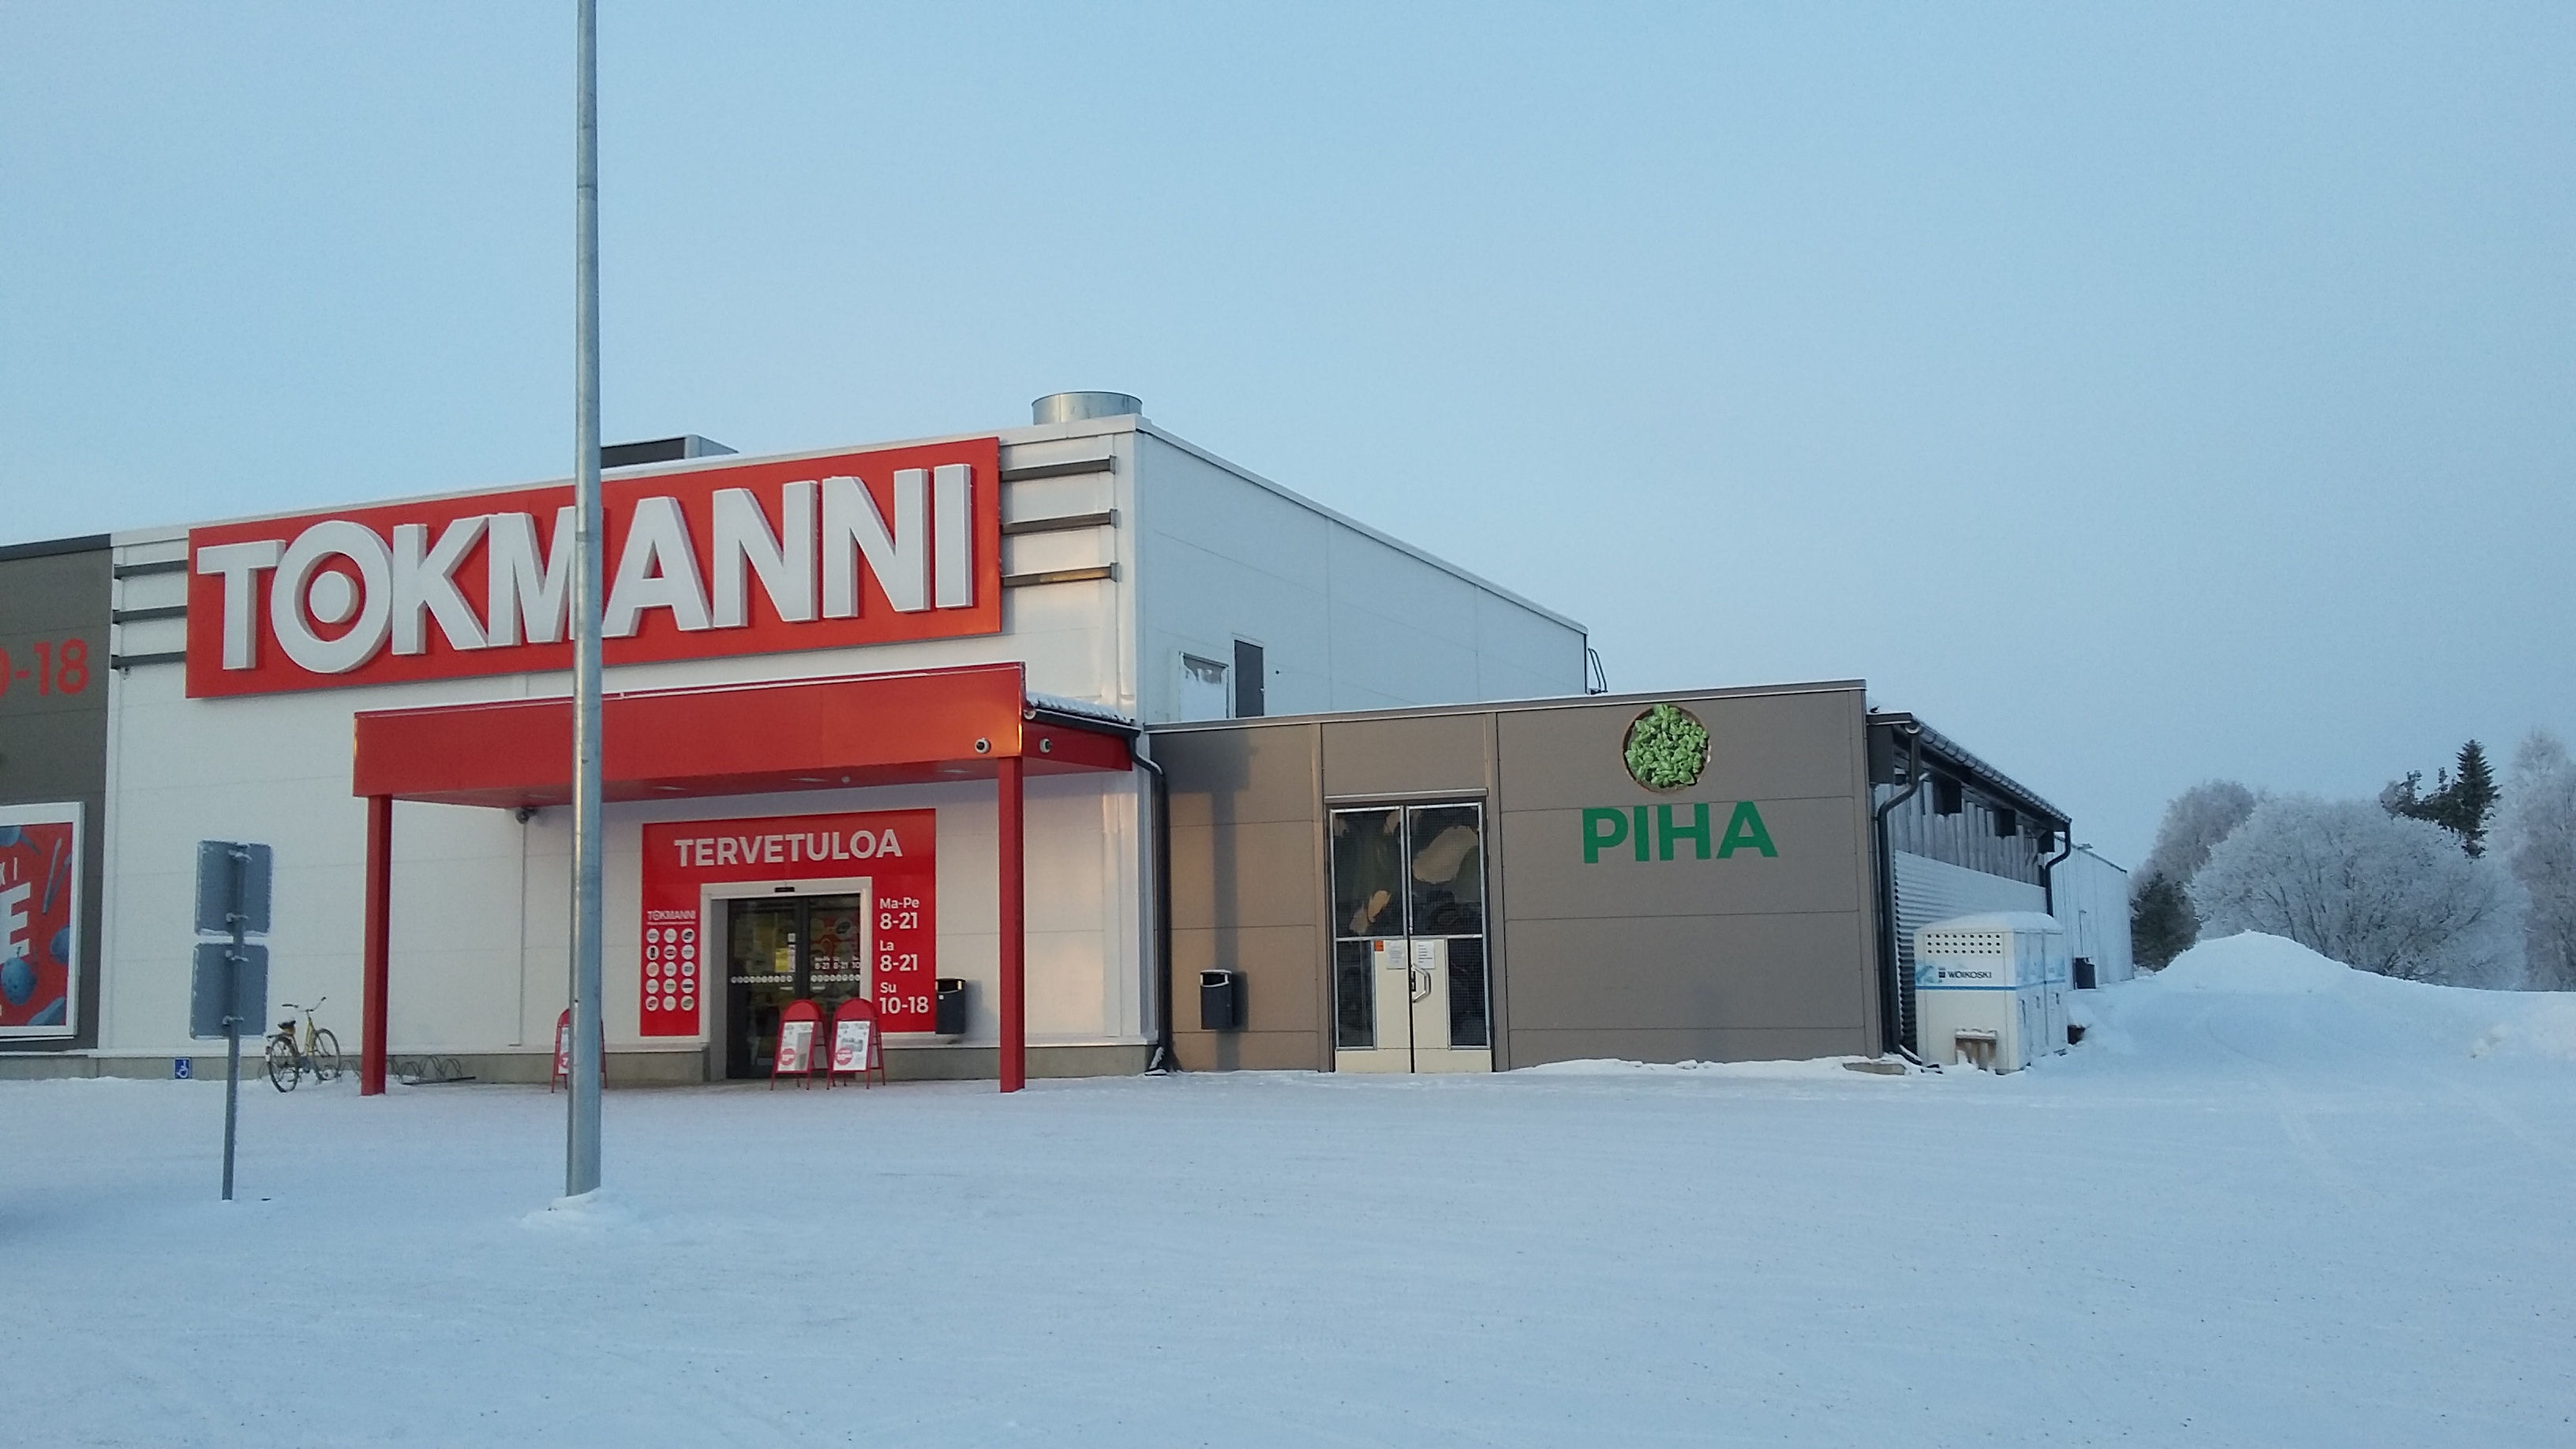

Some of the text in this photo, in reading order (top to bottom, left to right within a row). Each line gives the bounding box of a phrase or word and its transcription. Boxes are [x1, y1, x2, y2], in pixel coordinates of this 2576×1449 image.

[197, 463, 973, 675] TOKMANNI
[1582, 801, 1779, 863] PIHA
[674, 829, 903, 867] TERVETULOA
[879, 897, 919, 908] Ma-Pe
[879, 912, 918, 930] 8-21
[879, 940, 894, 951] La
[879, 954, 918, 972] 8-21
[879, 982, 897, 993] Su
[879, 996, 929, 1014] 10-18
